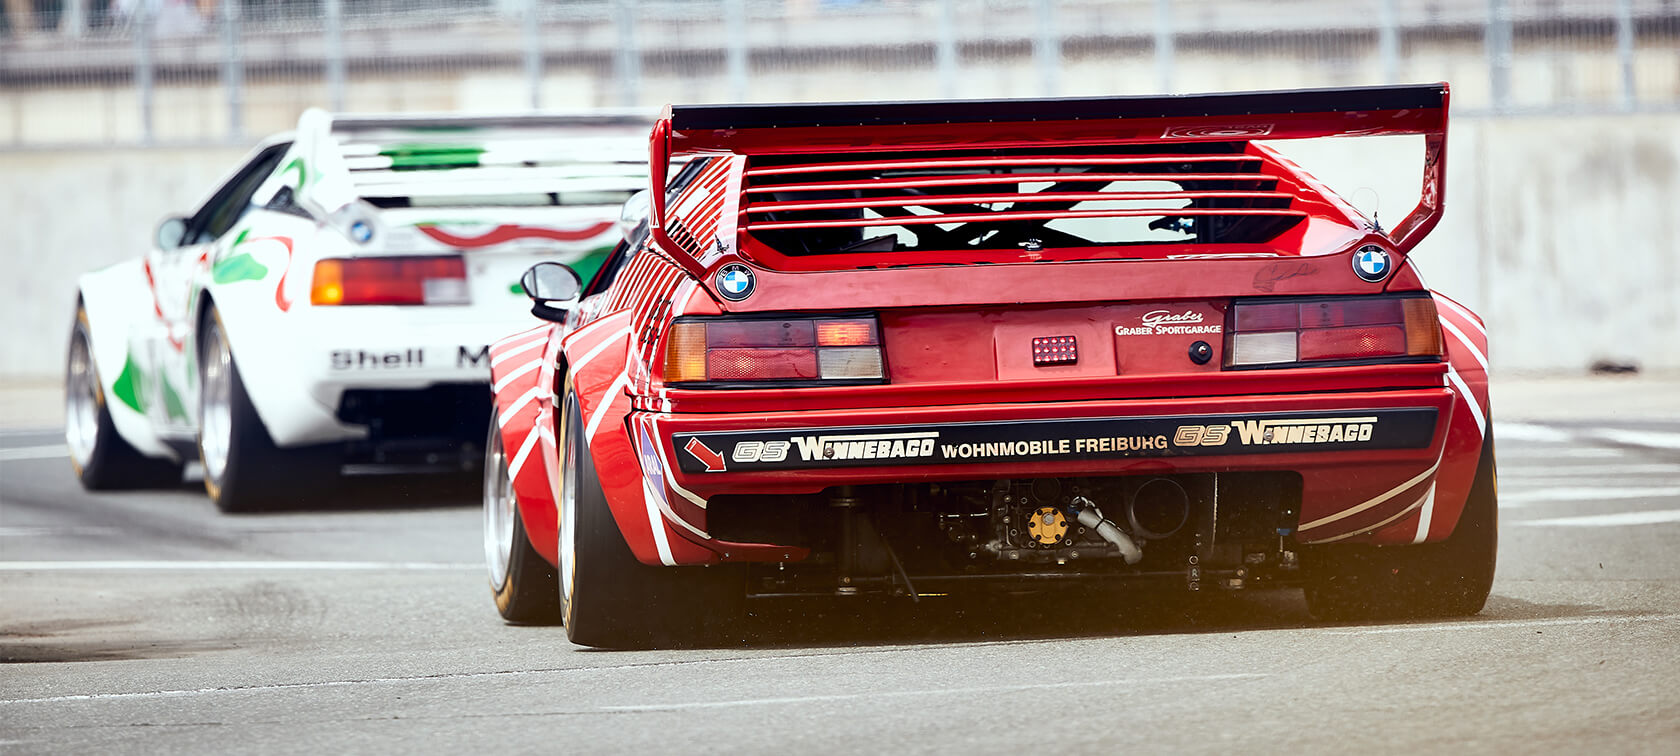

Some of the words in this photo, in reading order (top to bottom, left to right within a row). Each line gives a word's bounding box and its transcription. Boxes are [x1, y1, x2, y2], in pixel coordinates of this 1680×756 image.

[1142, 310, 1204, 328] Graber
[1115, 326, 1153, 336] GRABER
[1156, 325, 1222, 335] SPORTGARAGE
[332, 349, 423, 369] Shell
[732, 441, 791, 462] GS
[941, 439, 1070, 459] WOHNMOBILE
[1075, 435, 1168, 452] FREIBURG
[1173, 425, 1231, 447] GS
